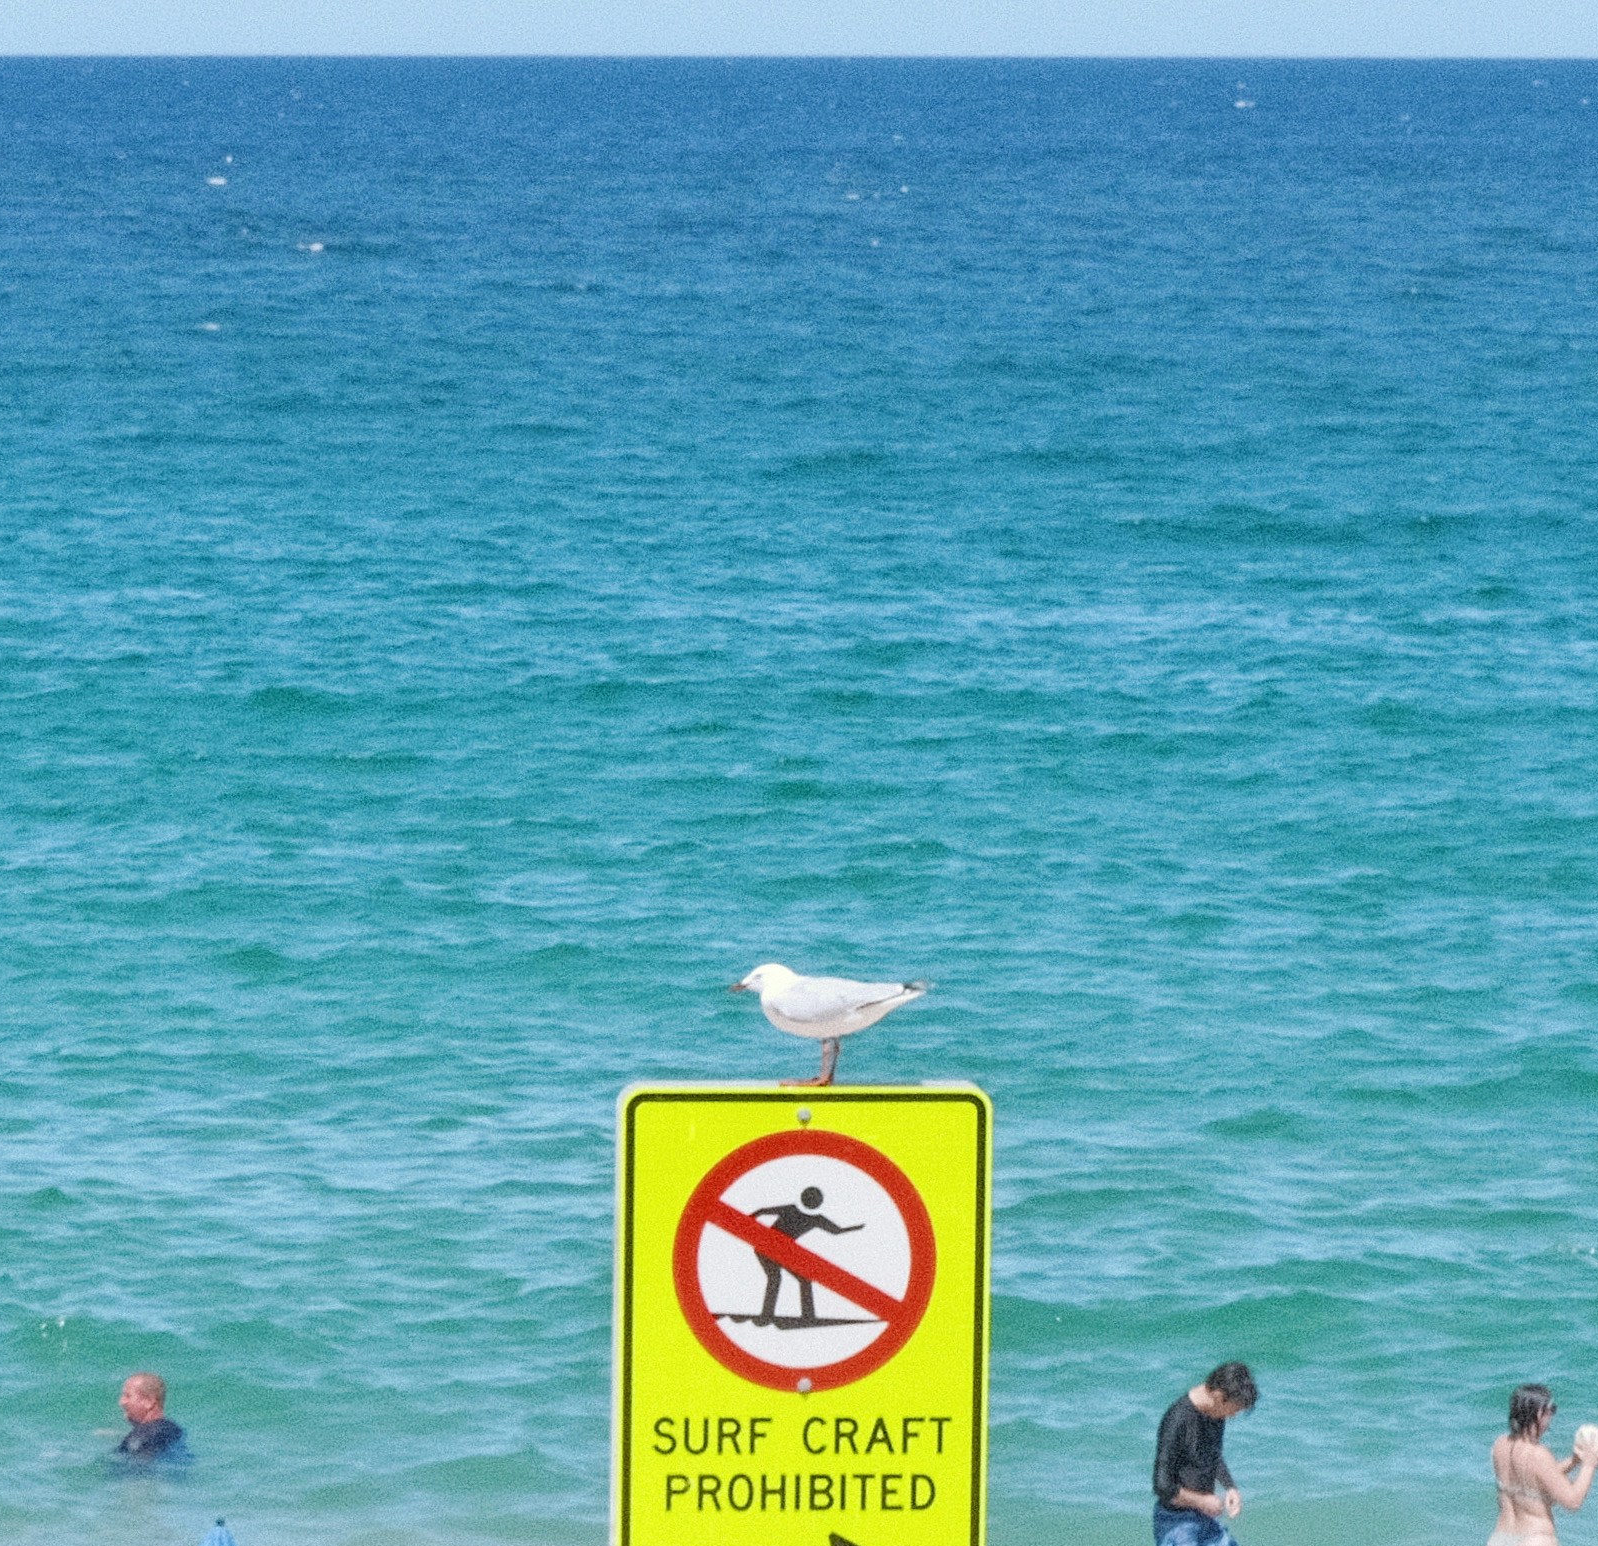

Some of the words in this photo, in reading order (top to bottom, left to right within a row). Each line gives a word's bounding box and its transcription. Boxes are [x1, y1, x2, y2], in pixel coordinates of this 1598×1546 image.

[653, 1416, 771, 1455] SURF
[802, 1416, 952, 1455] CRAFT
[665, 1473, 936, 1511] PROHIBITED
